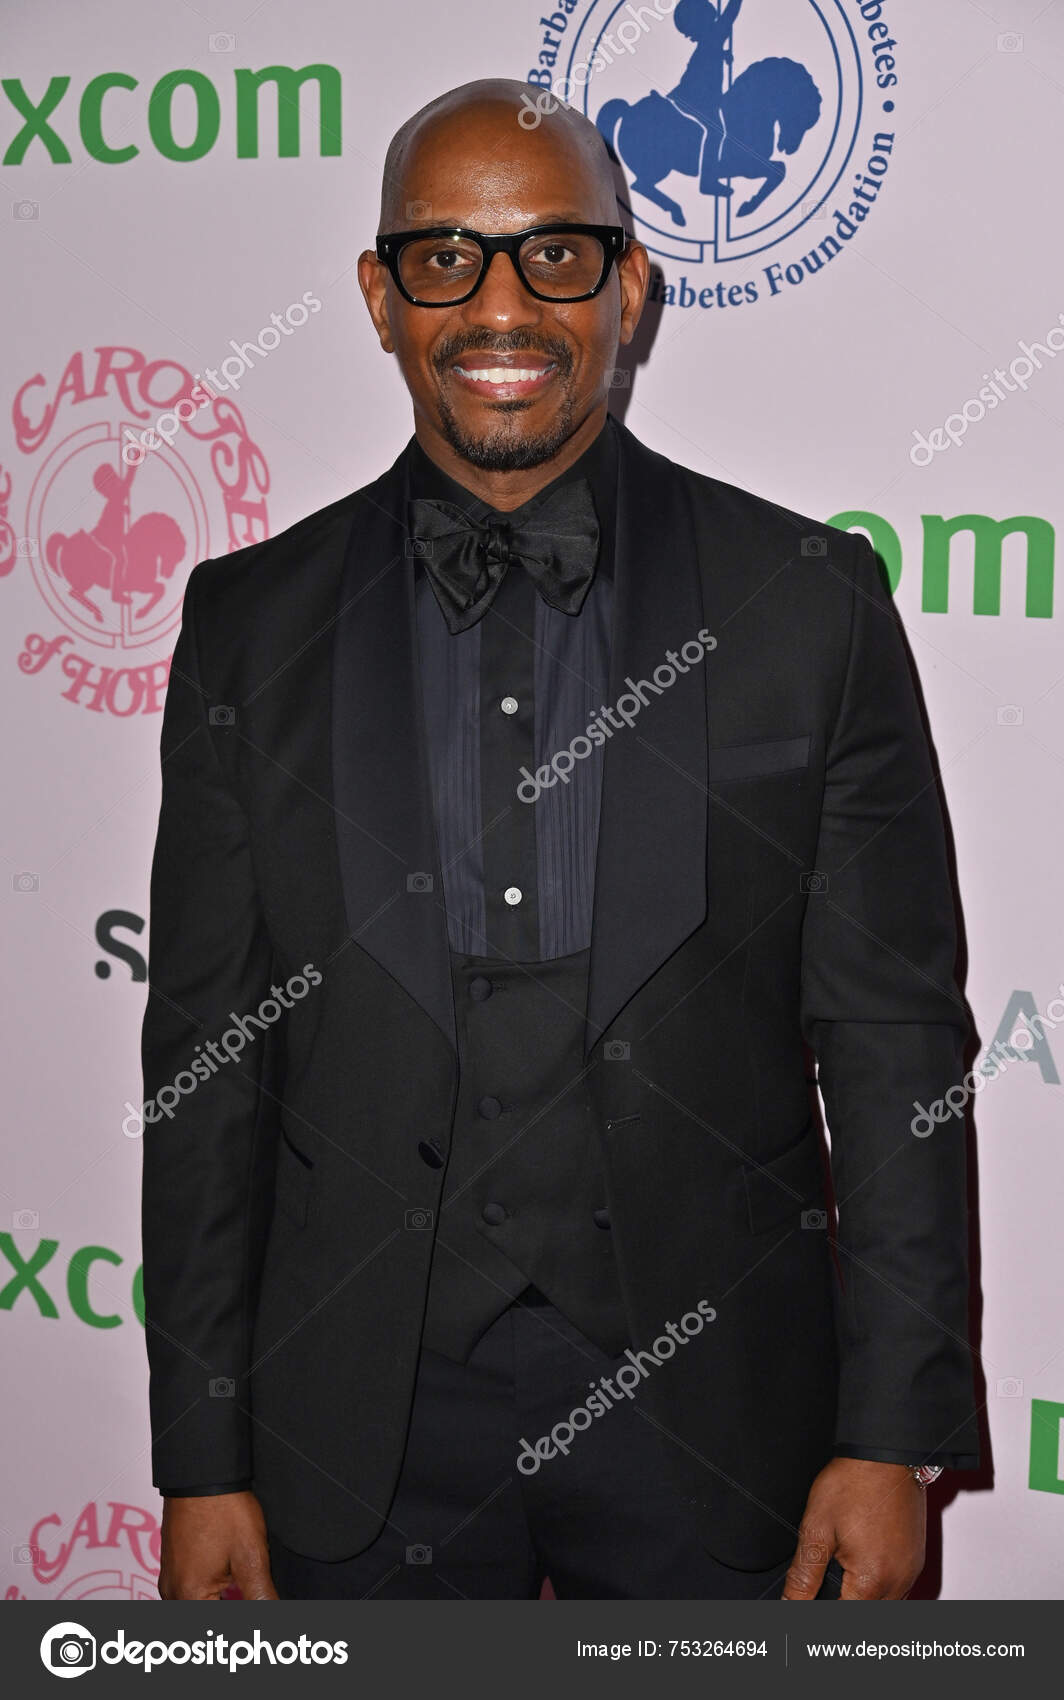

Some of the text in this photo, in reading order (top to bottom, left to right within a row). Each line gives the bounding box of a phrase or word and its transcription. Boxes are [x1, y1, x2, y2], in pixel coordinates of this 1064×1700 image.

[856, 0, 898, 88] betes
[1, 64, 342, 165] xcom
[762, 132, 895, 296] Foundation
[12, 346, 271, 555] CAROUSE
[60, 652, 175, 717] HOP
[0, 1230, 146, 1330] xc
[29, 1501, 161, 1584] CAR
